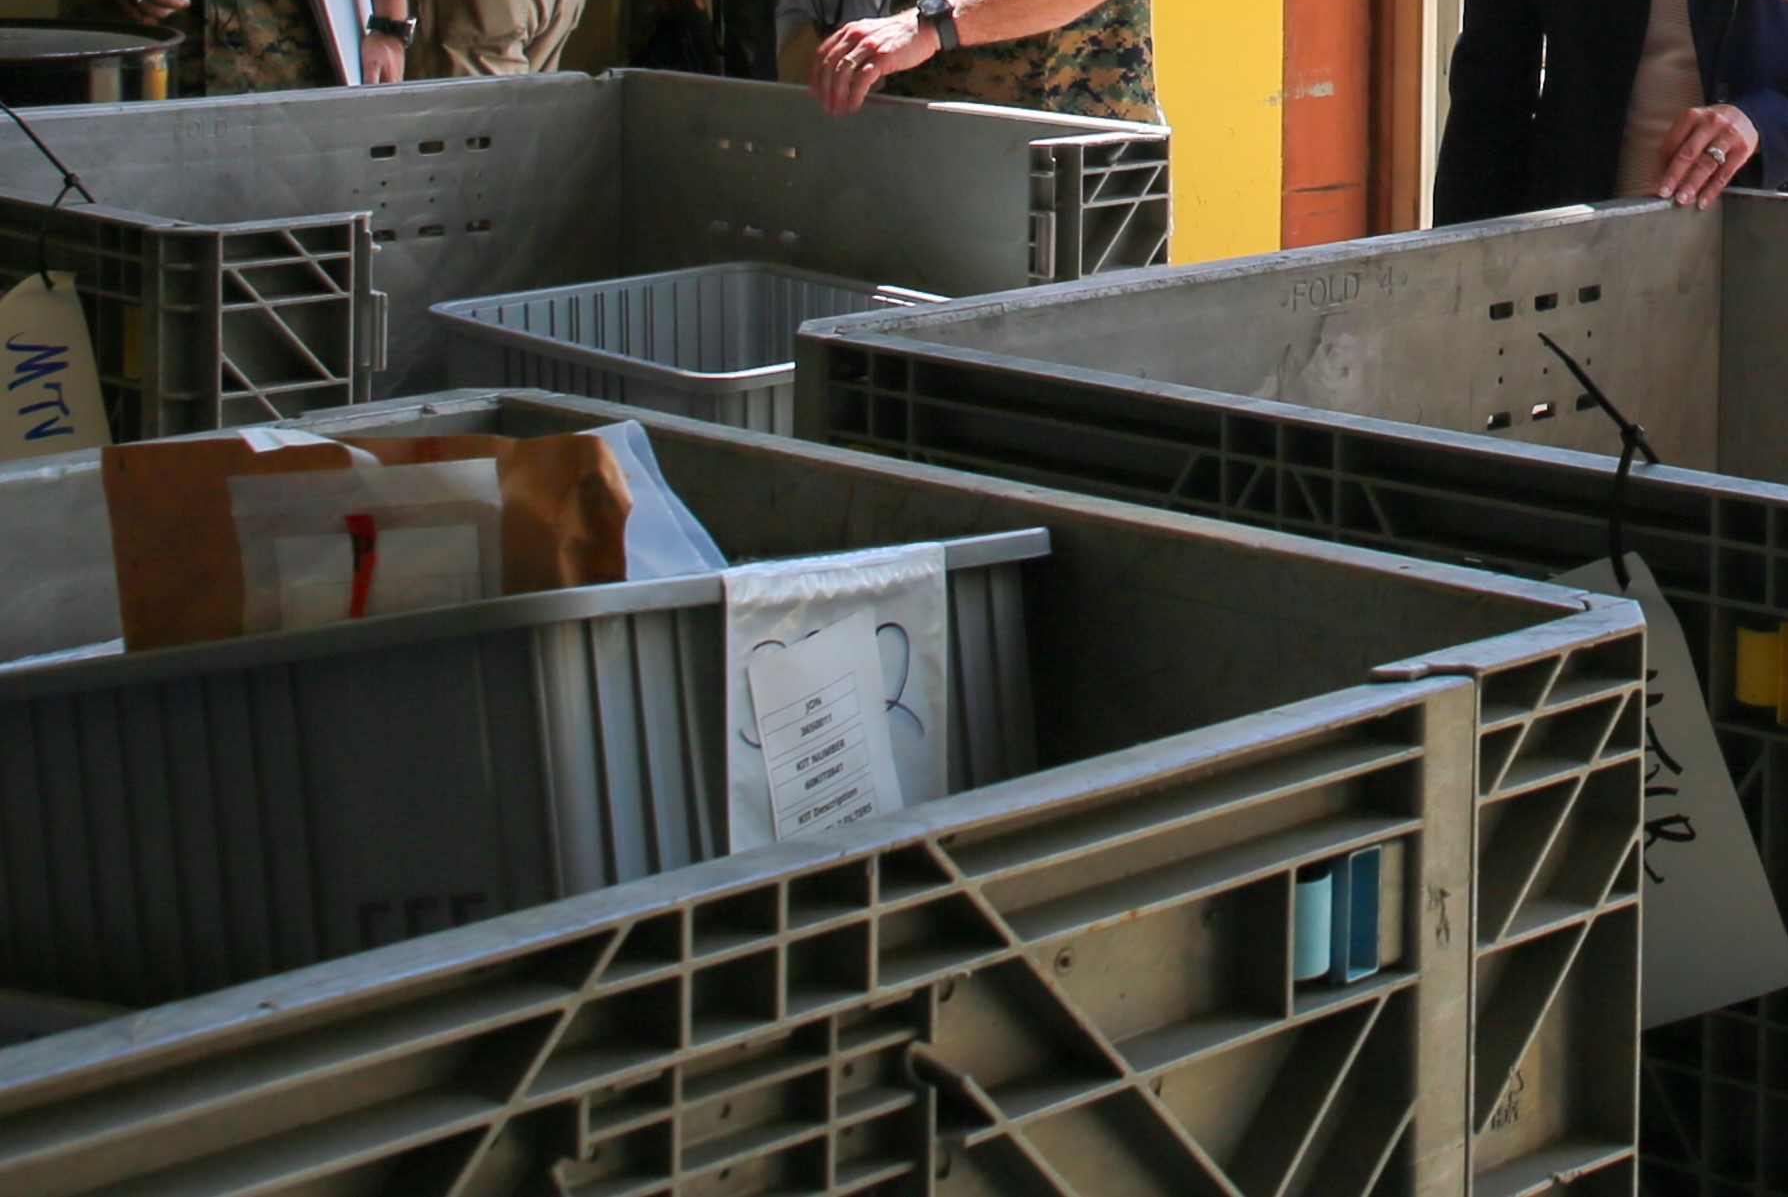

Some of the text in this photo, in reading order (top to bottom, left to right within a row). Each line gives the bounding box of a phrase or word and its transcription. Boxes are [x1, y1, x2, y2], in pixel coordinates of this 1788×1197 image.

[1292, 271, 1361, 311] FOLD
[796, 738, 845, 772] KIT NUMBER
[798, 810, 812, 825] KIT
[813, 787, 859, 818] Description
